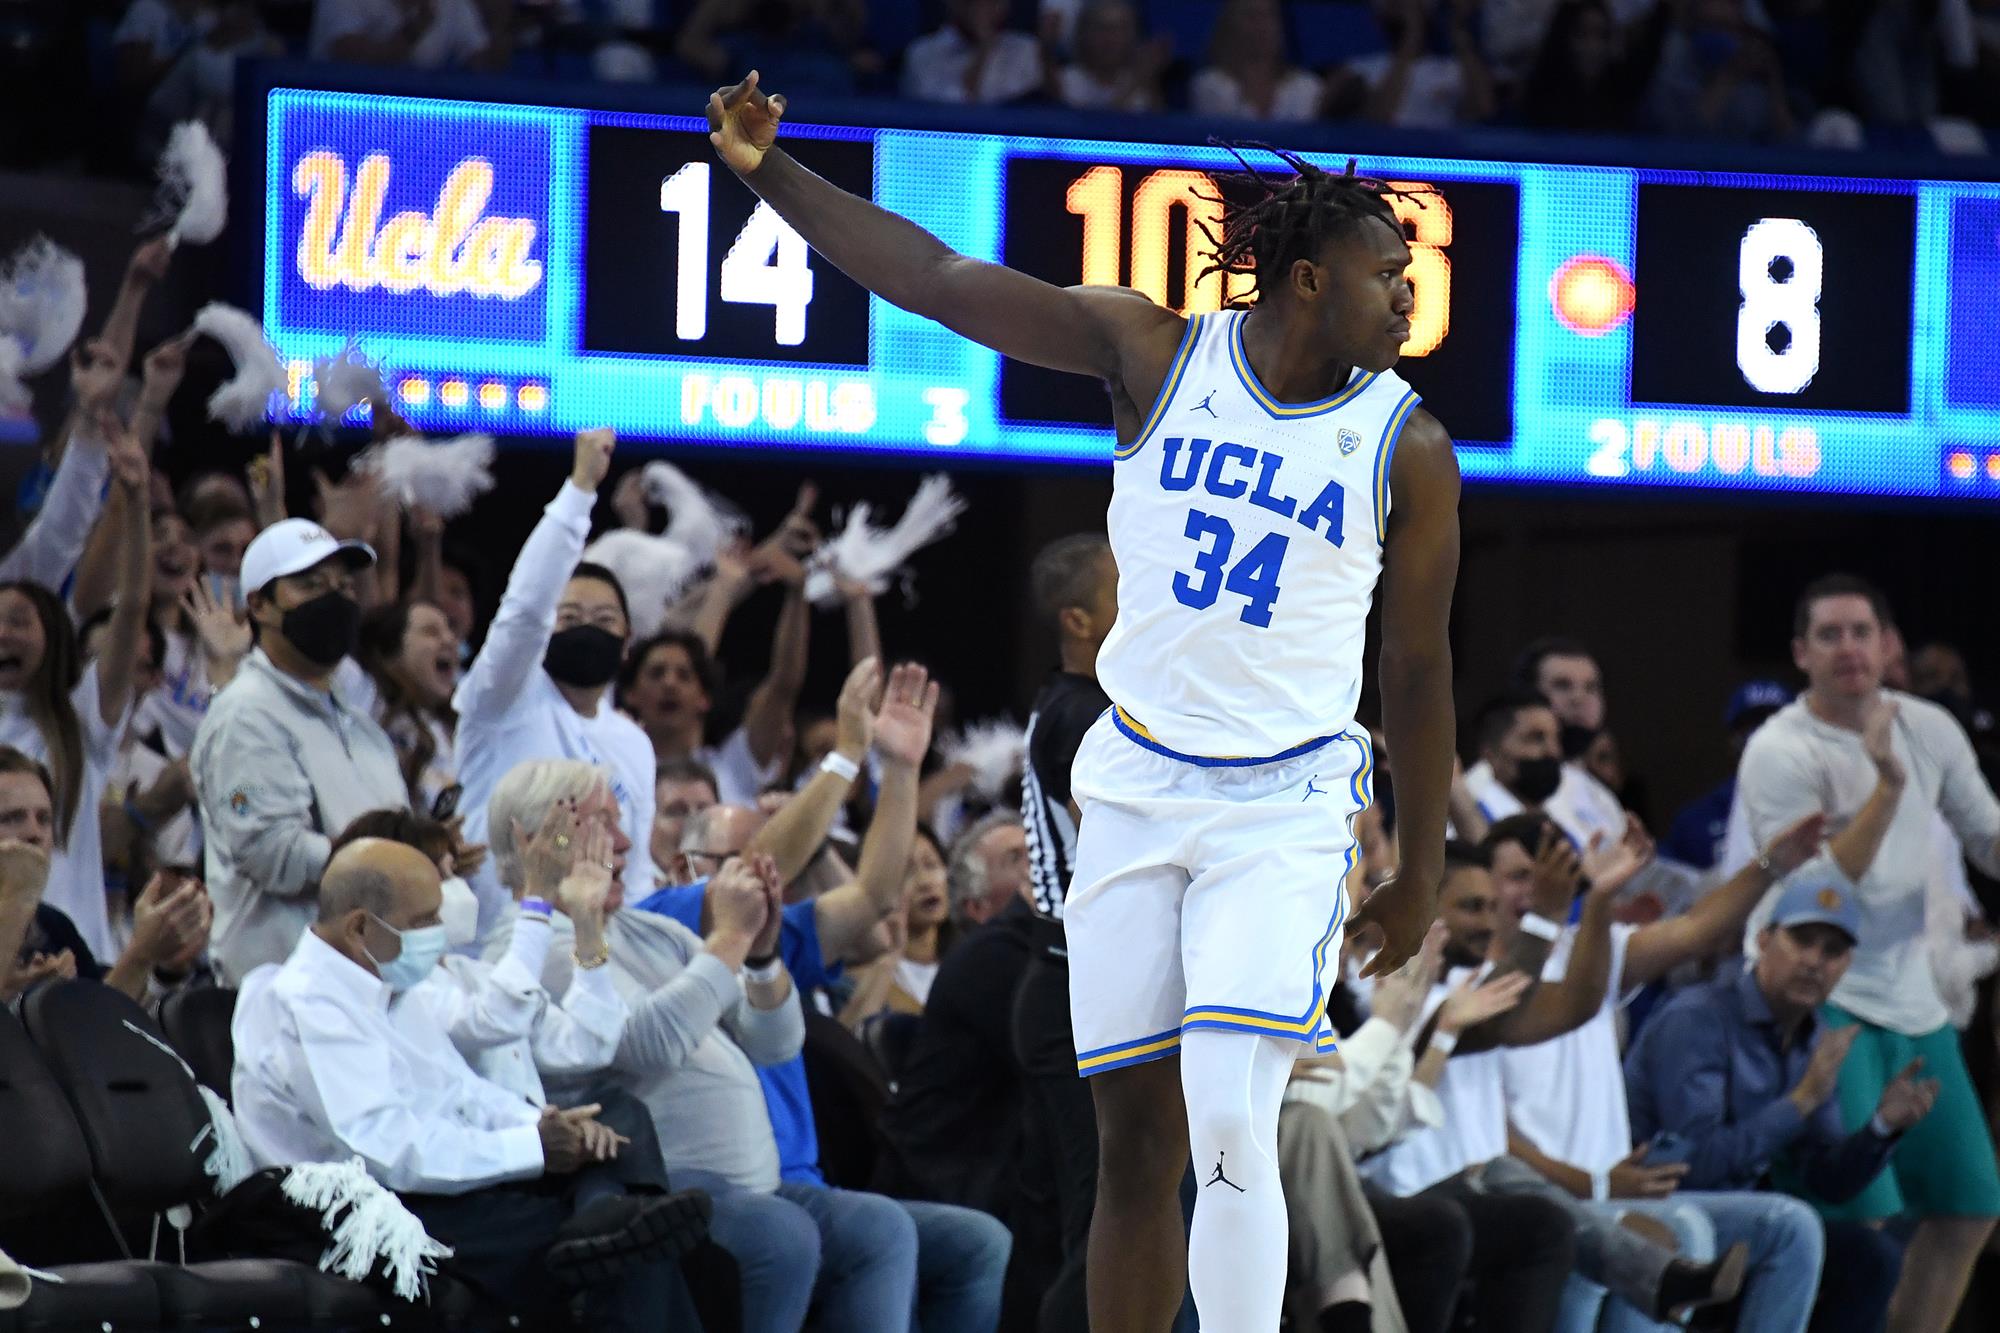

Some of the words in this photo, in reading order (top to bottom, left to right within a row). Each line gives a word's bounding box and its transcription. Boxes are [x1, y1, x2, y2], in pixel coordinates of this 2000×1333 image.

[660, 161, 813, 345] 14
[1736, 217, 1823, 394] 8
[681, 374, 876, 433] FOULS
[923, 387, 969, 446] 3
[1586, 418, 1630, 477] 2
[1632, 419, 1822, 478] FOULS
[1160, 437, 1345, 549] UCLA
[1172, 508, 1290, 628] 34
